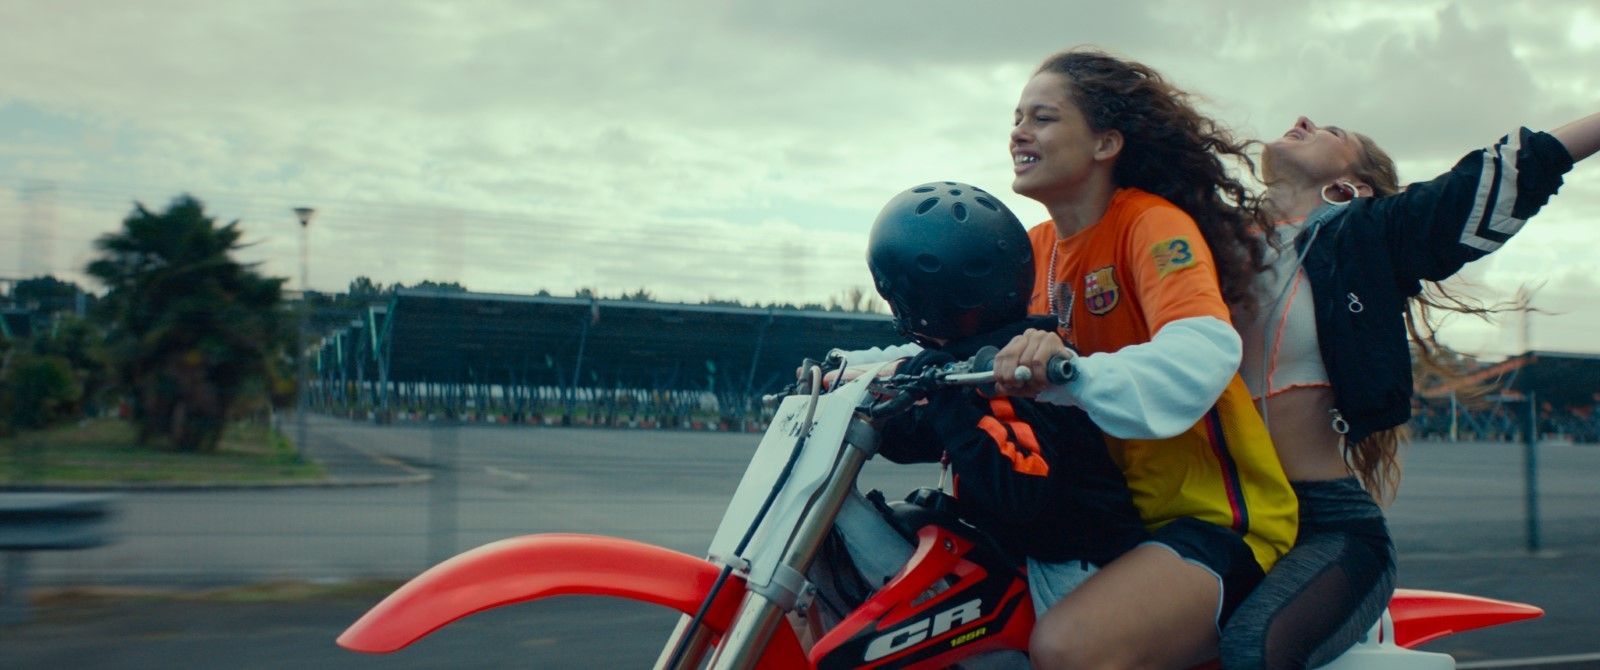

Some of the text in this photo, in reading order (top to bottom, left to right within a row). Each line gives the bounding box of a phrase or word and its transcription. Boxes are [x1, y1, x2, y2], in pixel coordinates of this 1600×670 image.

[1168, 239, 1192, 264] 3
[864, 598, 983, 662] CR
[950, 626, 986, 647] 125R
